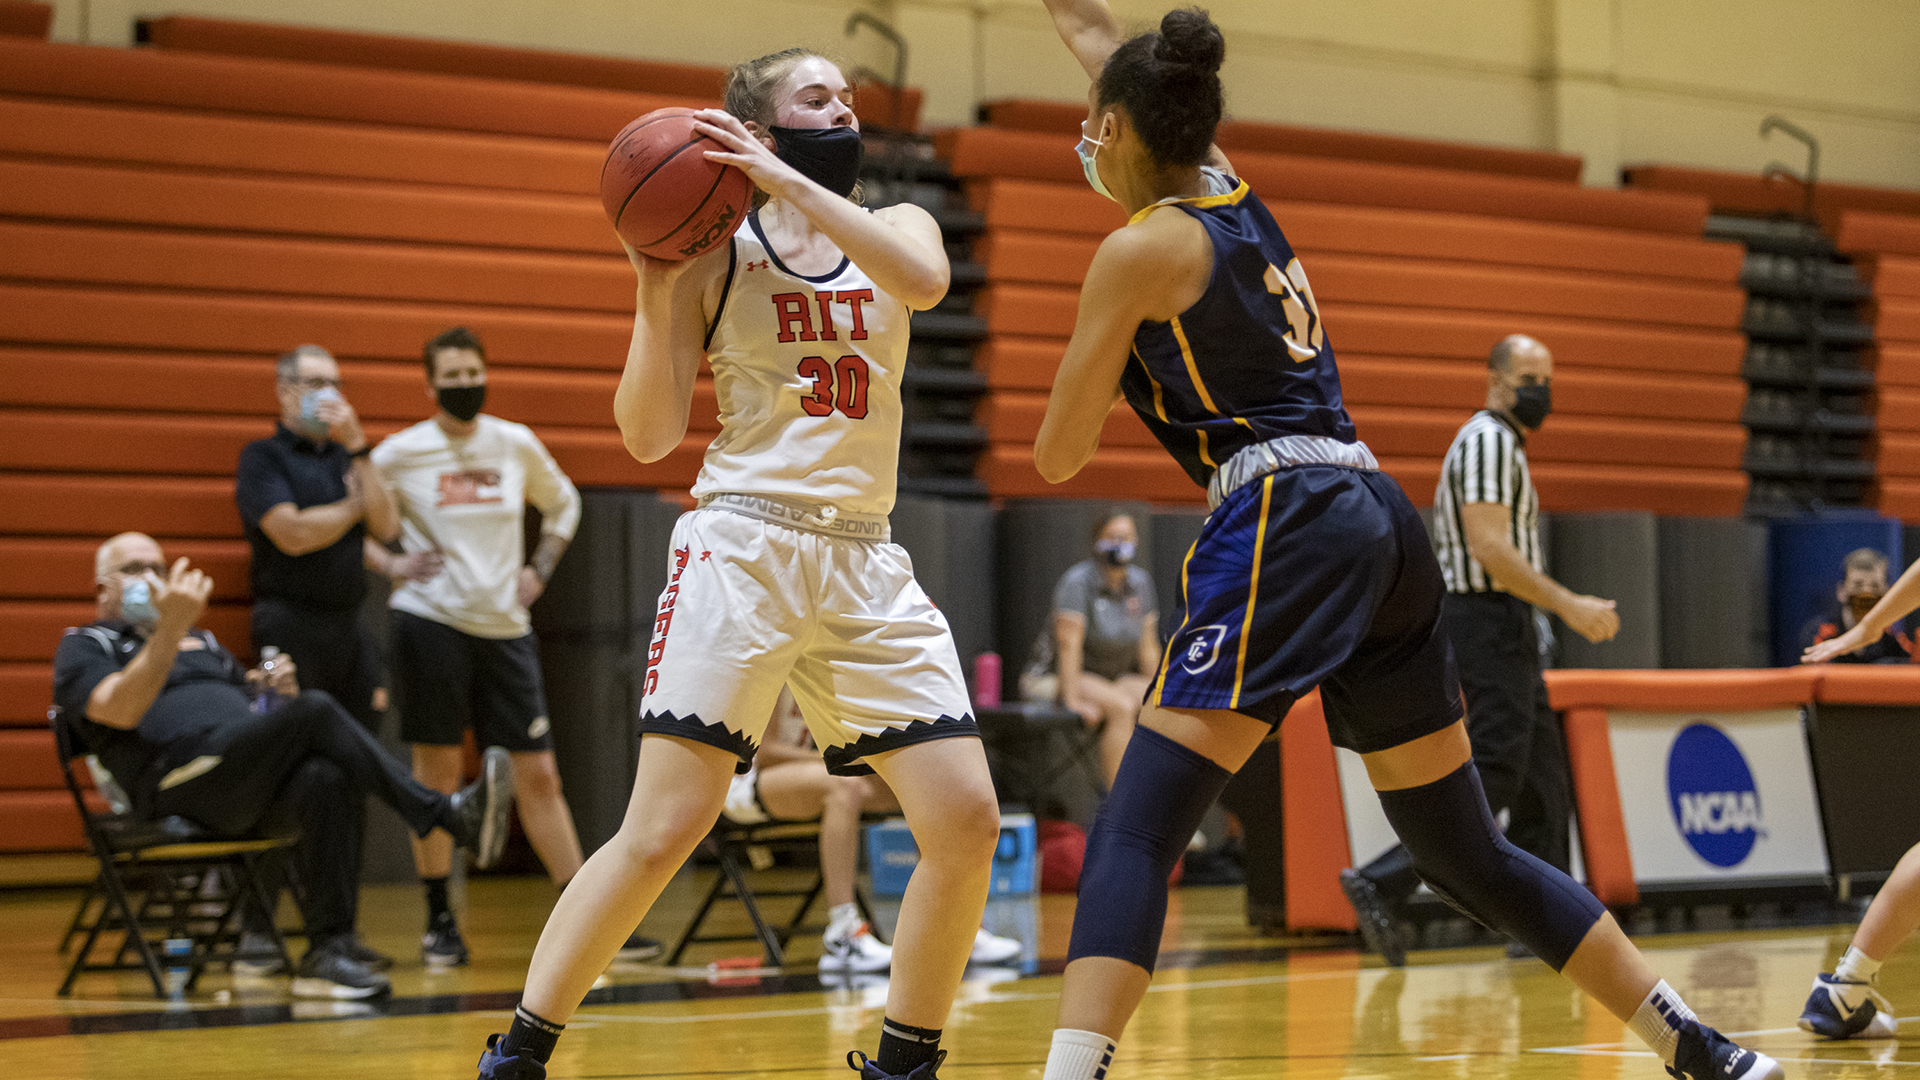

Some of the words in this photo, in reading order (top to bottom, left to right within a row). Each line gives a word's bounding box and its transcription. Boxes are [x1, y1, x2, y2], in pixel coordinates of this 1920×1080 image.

[678, 203, 736, 256] NCAA
[772, 288, 874, 343] RIT
[797, 355, 869, 420] 30
[824, 517, 883, 536] UNDE
[1678, 791, 1762, 835] NCAA
